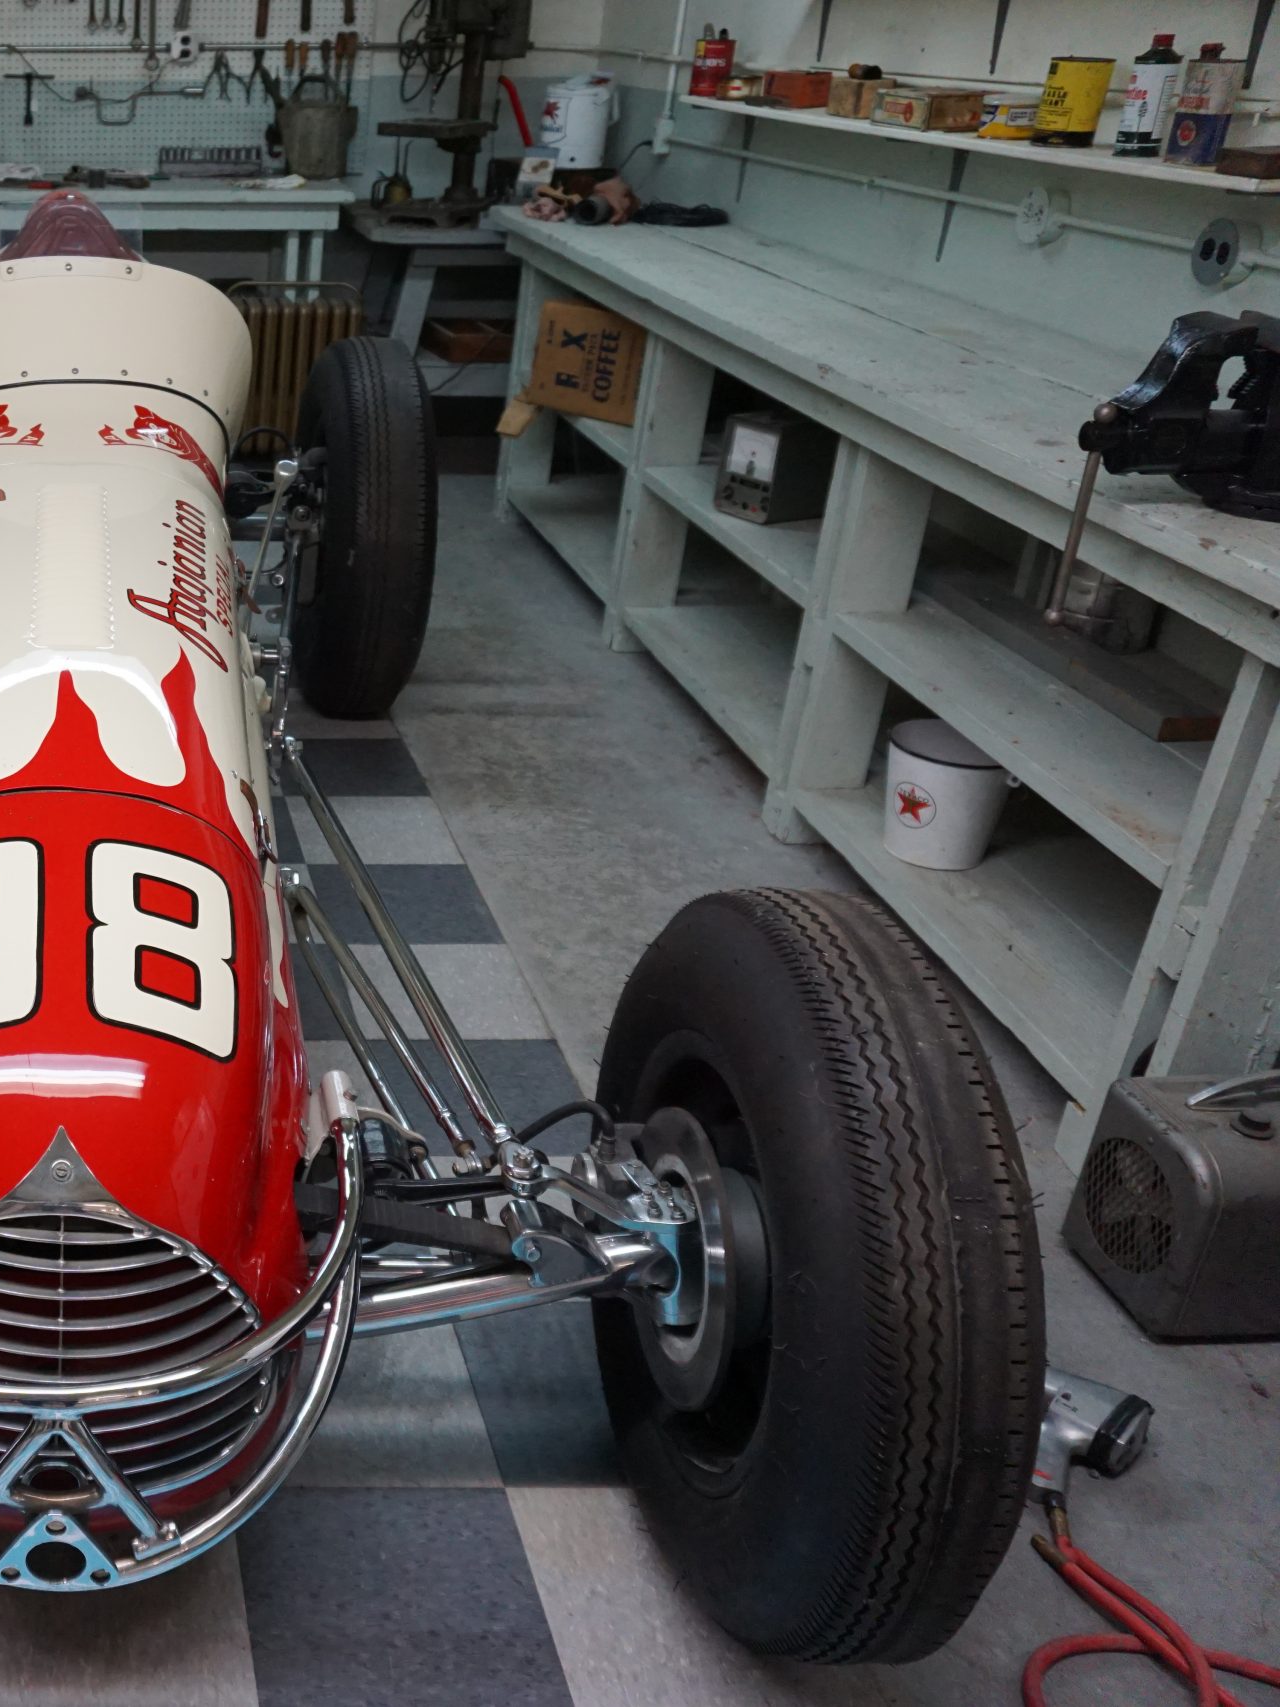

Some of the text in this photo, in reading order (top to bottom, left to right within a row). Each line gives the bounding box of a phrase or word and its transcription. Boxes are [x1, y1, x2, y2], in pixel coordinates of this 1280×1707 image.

[592, 327, 621, 404] COFFEE
[126, 499, 230, 674] Agajanian
[215, 553, 234, 638] SPECIAL
